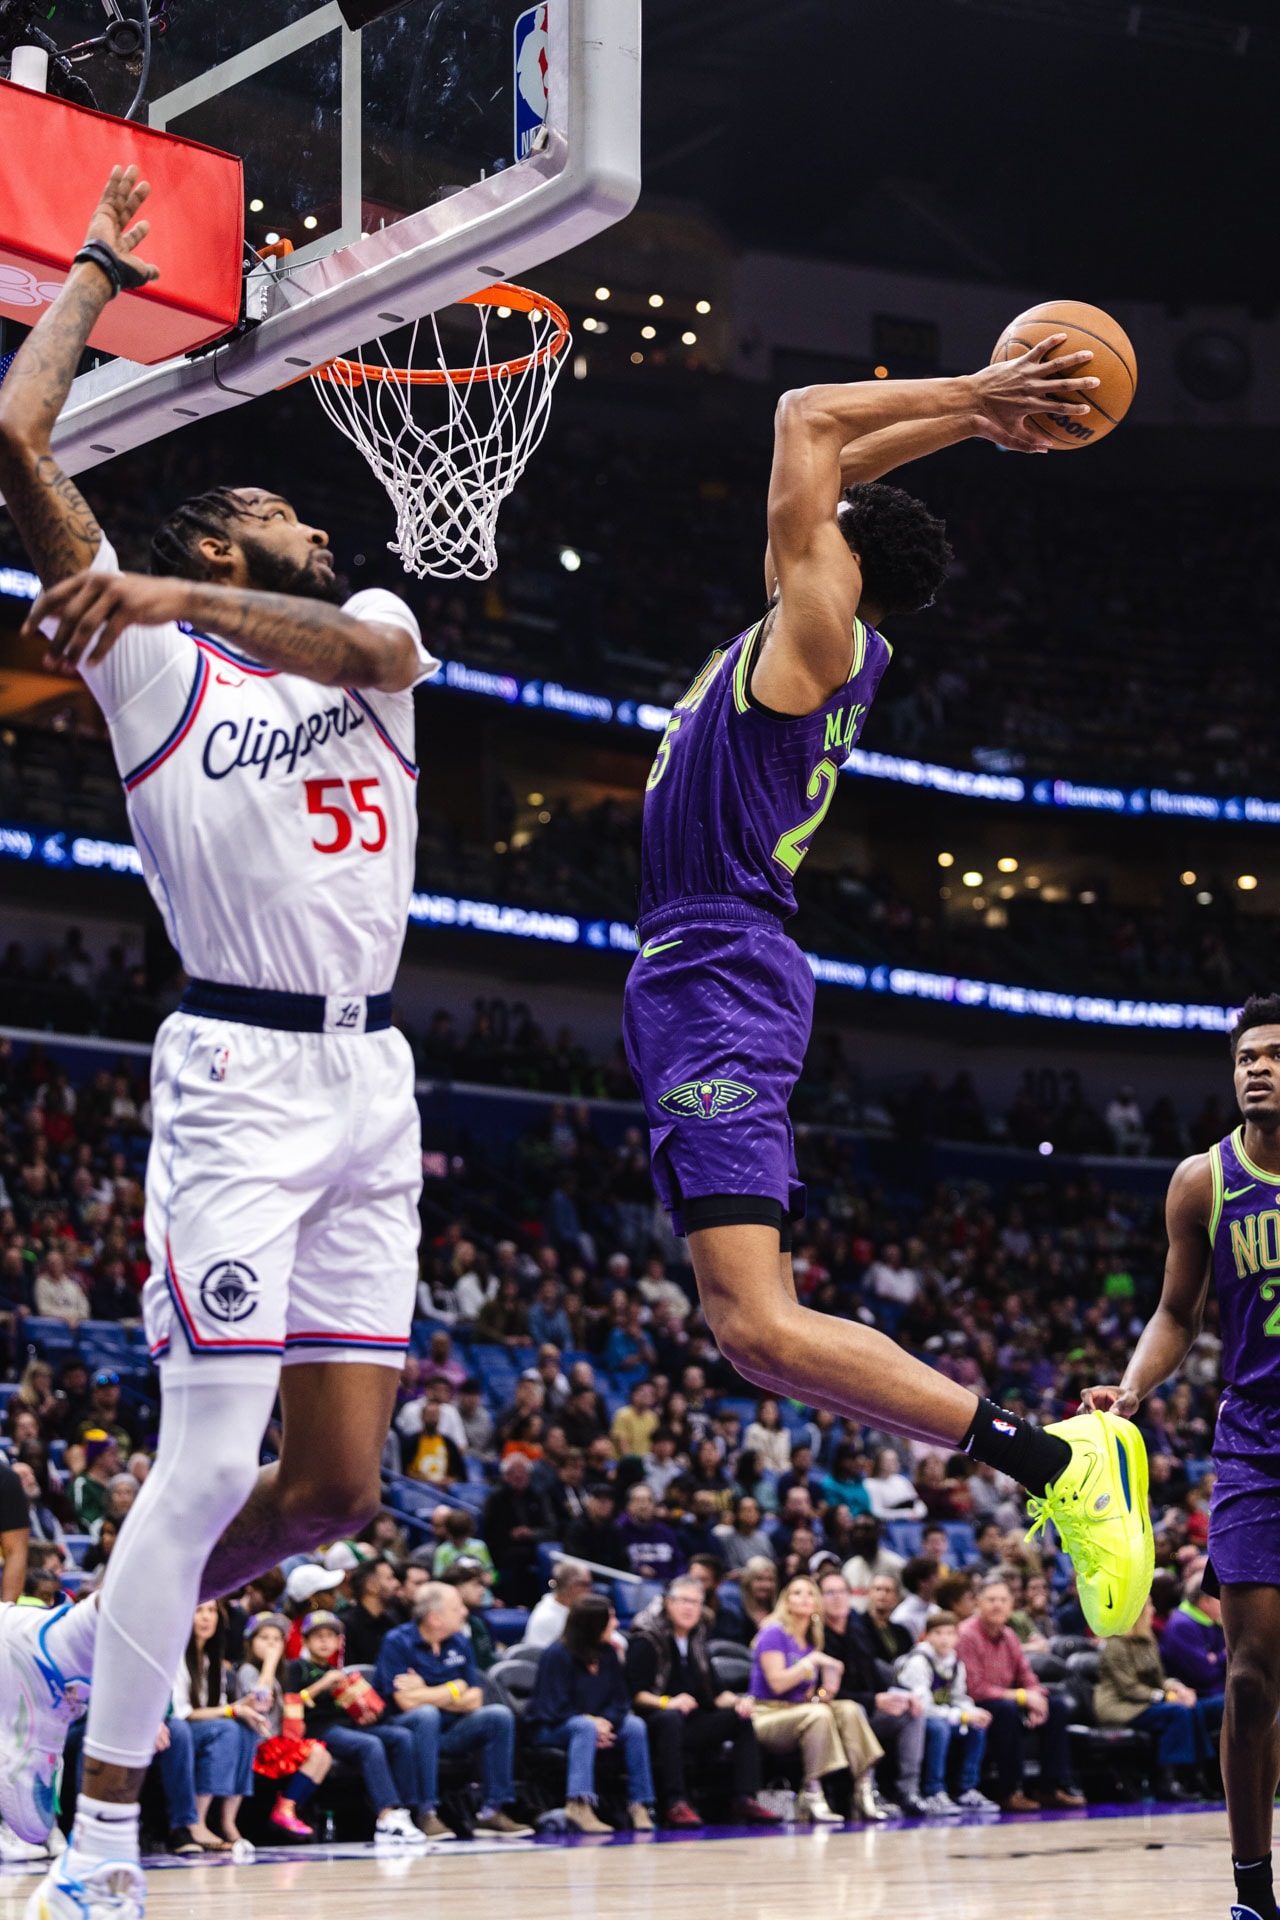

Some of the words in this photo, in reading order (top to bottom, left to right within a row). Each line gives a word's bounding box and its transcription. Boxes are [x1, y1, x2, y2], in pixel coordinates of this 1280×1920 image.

[203, 697, 364, 780] Clippers
[645, 716, 682, 793] 5
[303, 777, 388, 855] 55
[456, 899, 579, 943] PELICANS
[1075, 996, 1183, 1028] ORLEANS
